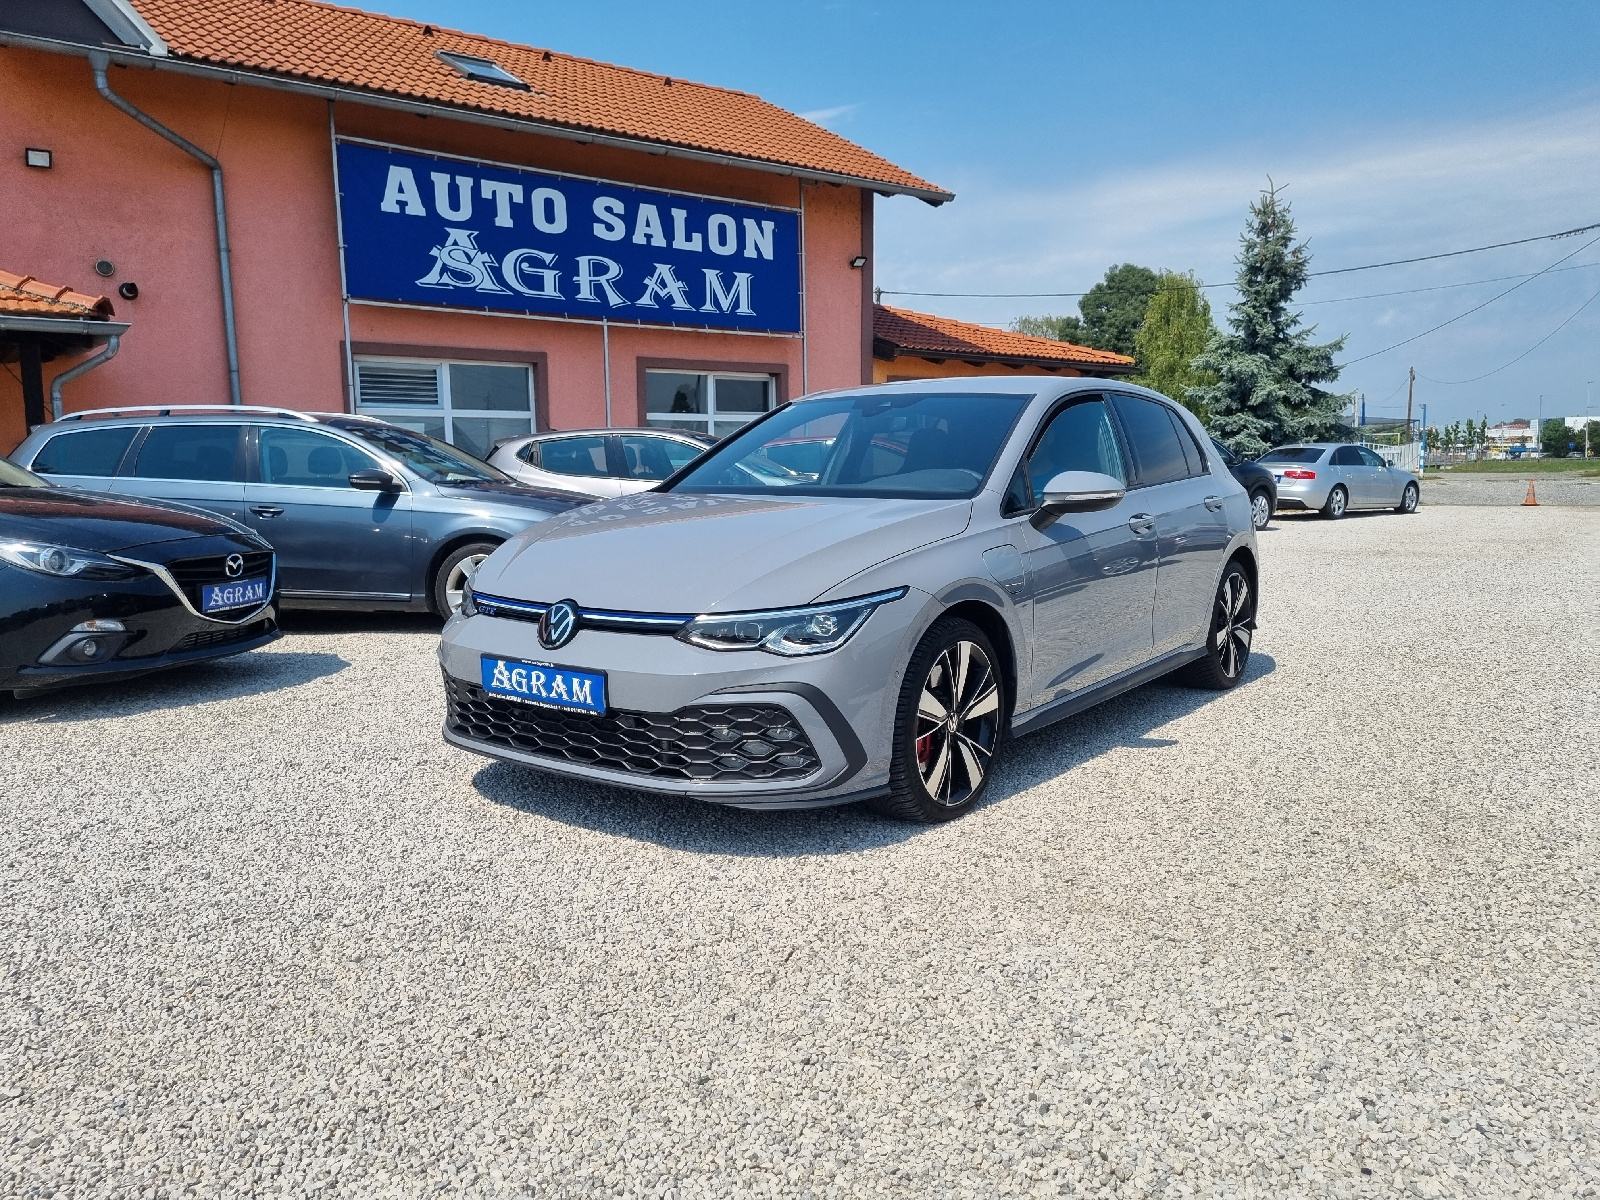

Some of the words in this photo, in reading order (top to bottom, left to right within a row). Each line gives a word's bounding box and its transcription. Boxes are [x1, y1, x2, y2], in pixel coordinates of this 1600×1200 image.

[380, 165, 568, 235] AUTO
[592, 196, 775, 261] SALON
[208, 582, 263, 607] AGRAM
[491, 660, 595, 706] AGRAM
